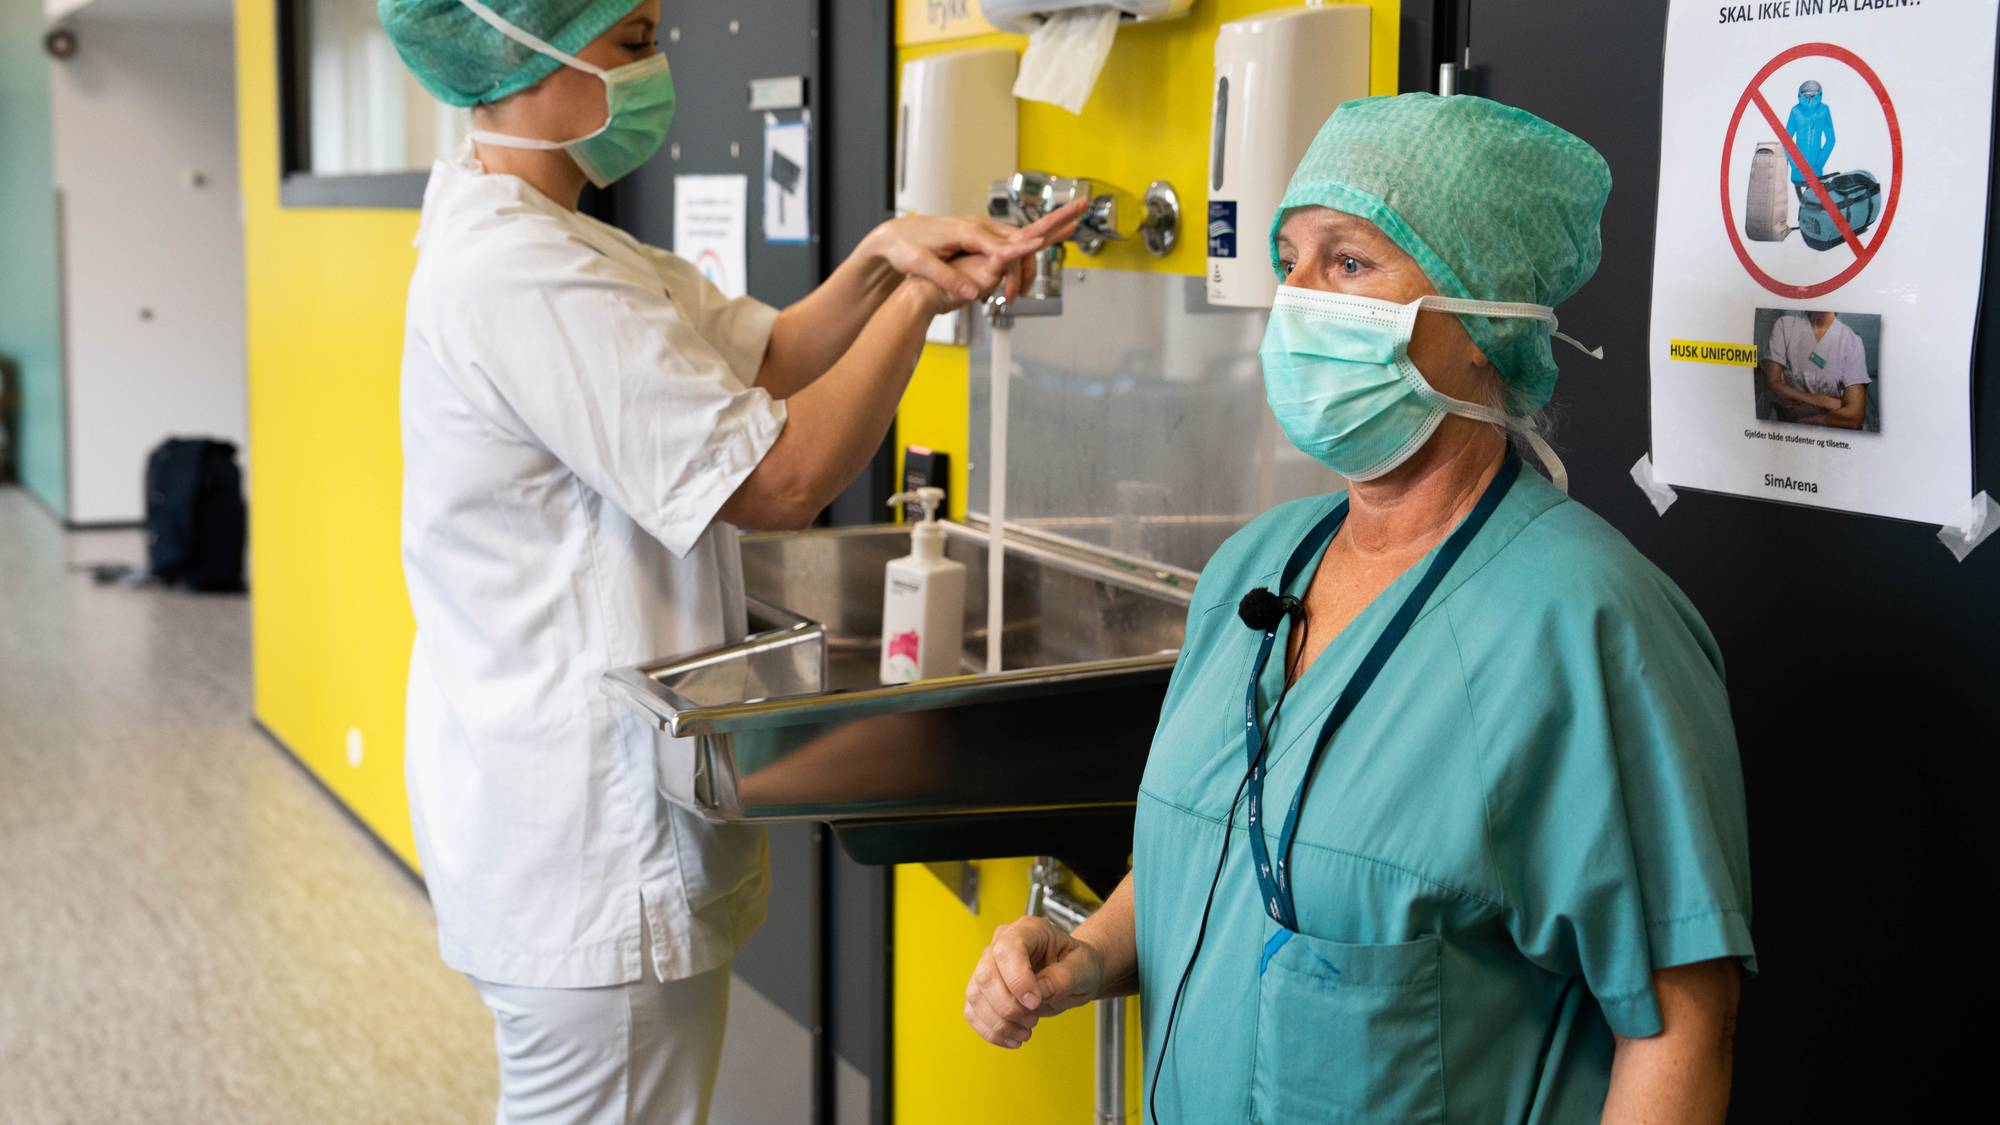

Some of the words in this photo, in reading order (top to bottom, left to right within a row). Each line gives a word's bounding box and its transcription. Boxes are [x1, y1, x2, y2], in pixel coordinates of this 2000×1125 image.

[1718, 5, 1754, 24] SKAL
[1758, 1, 1791, 20] IKKE
[1795, 0, 1824, 16] INN
[1670, 344, 1698, 358] HUSK
[1701, 346, 1757, 363] UNIFORM!
[1744, 429, 1767, 440] Gjelder
[1768, 432, 1784, 441] både
[1785, 435, 1815, 446] studenter
[1816, 439, 1825, 448] og
[1764, 473, 1818, 493] SimArena
